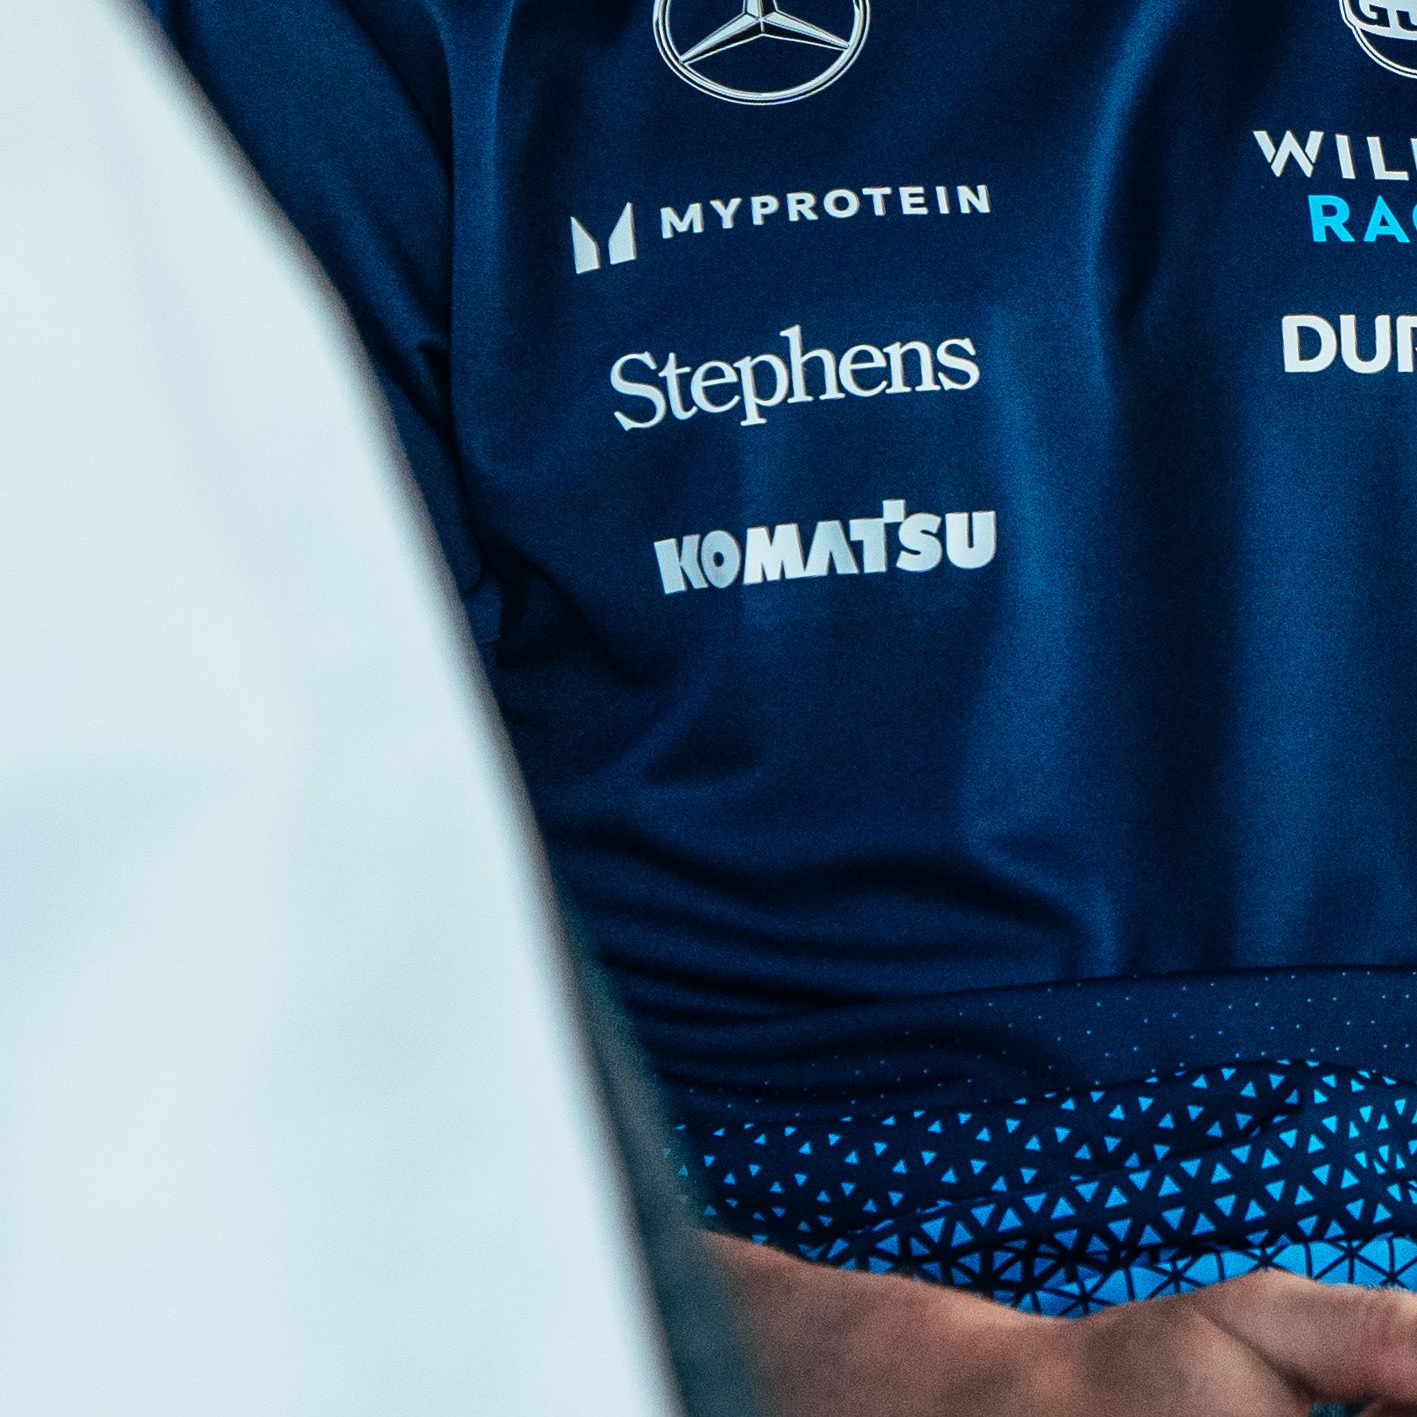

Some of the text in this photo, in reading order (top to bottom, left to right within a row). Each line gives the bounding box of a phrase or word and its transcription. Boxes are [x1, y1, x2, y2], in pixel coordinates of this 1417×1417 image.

[660, 184, 992, 239] MYPROTEIN
[610, 324, 981, 432] Stephens
[653, 498, 996, 595] KOMATSU
